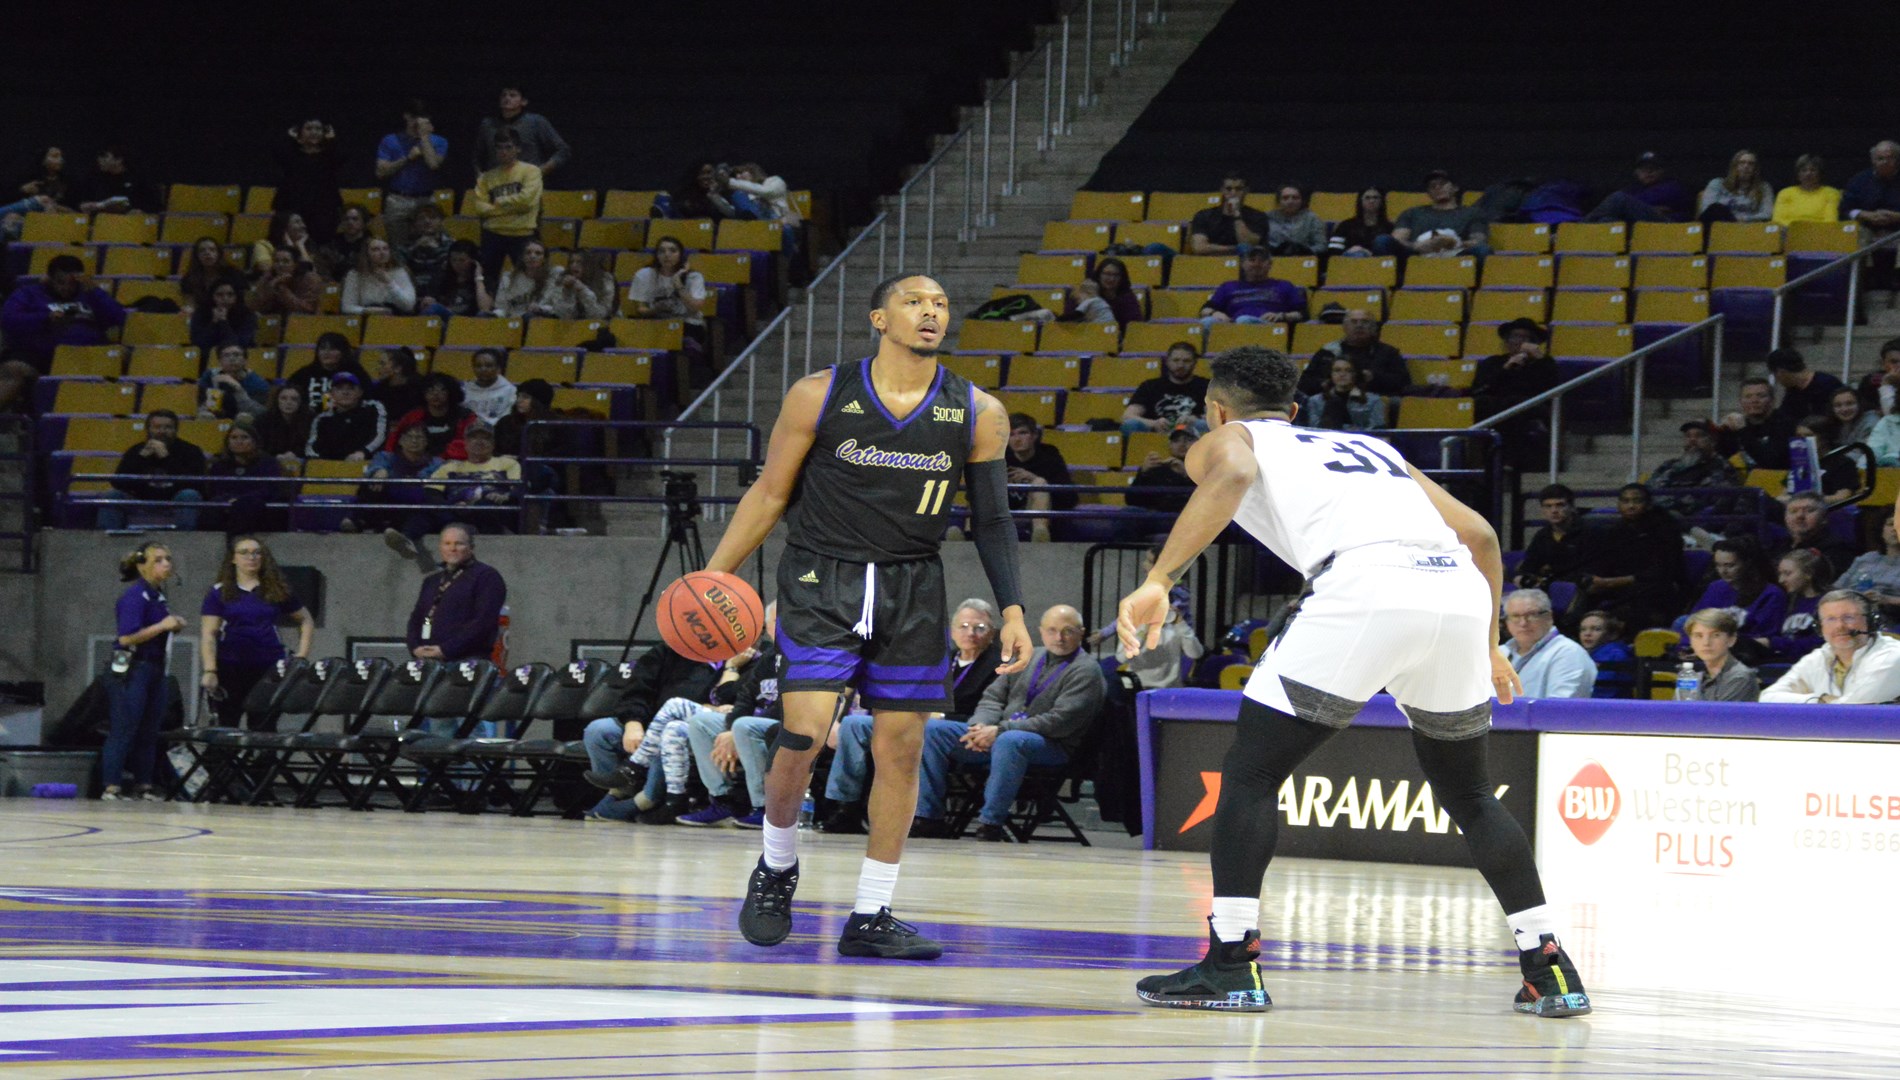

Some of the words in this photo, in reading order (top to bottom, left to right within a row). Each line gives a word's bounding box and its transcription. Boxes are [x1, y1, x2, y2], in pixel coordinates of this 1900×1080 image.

[836, 438, 952, 471] Catamounts
[1295, 434, 1413, 480] 31
[916, 480, 949, 515] 11
[683, 610, 719, 650] NCAA
[704, 585, 747, 642] Wilson
[1664, 753, 1730, 787] Best
[1278, 774, 1510, 834] ARAMA
[1564, 785, 1615, 821] BW
[1633, 788, 1758, 826] Western
[1655, 832, 1734, 868] PLUS
[1793, 829, 1850, 851] (828)
